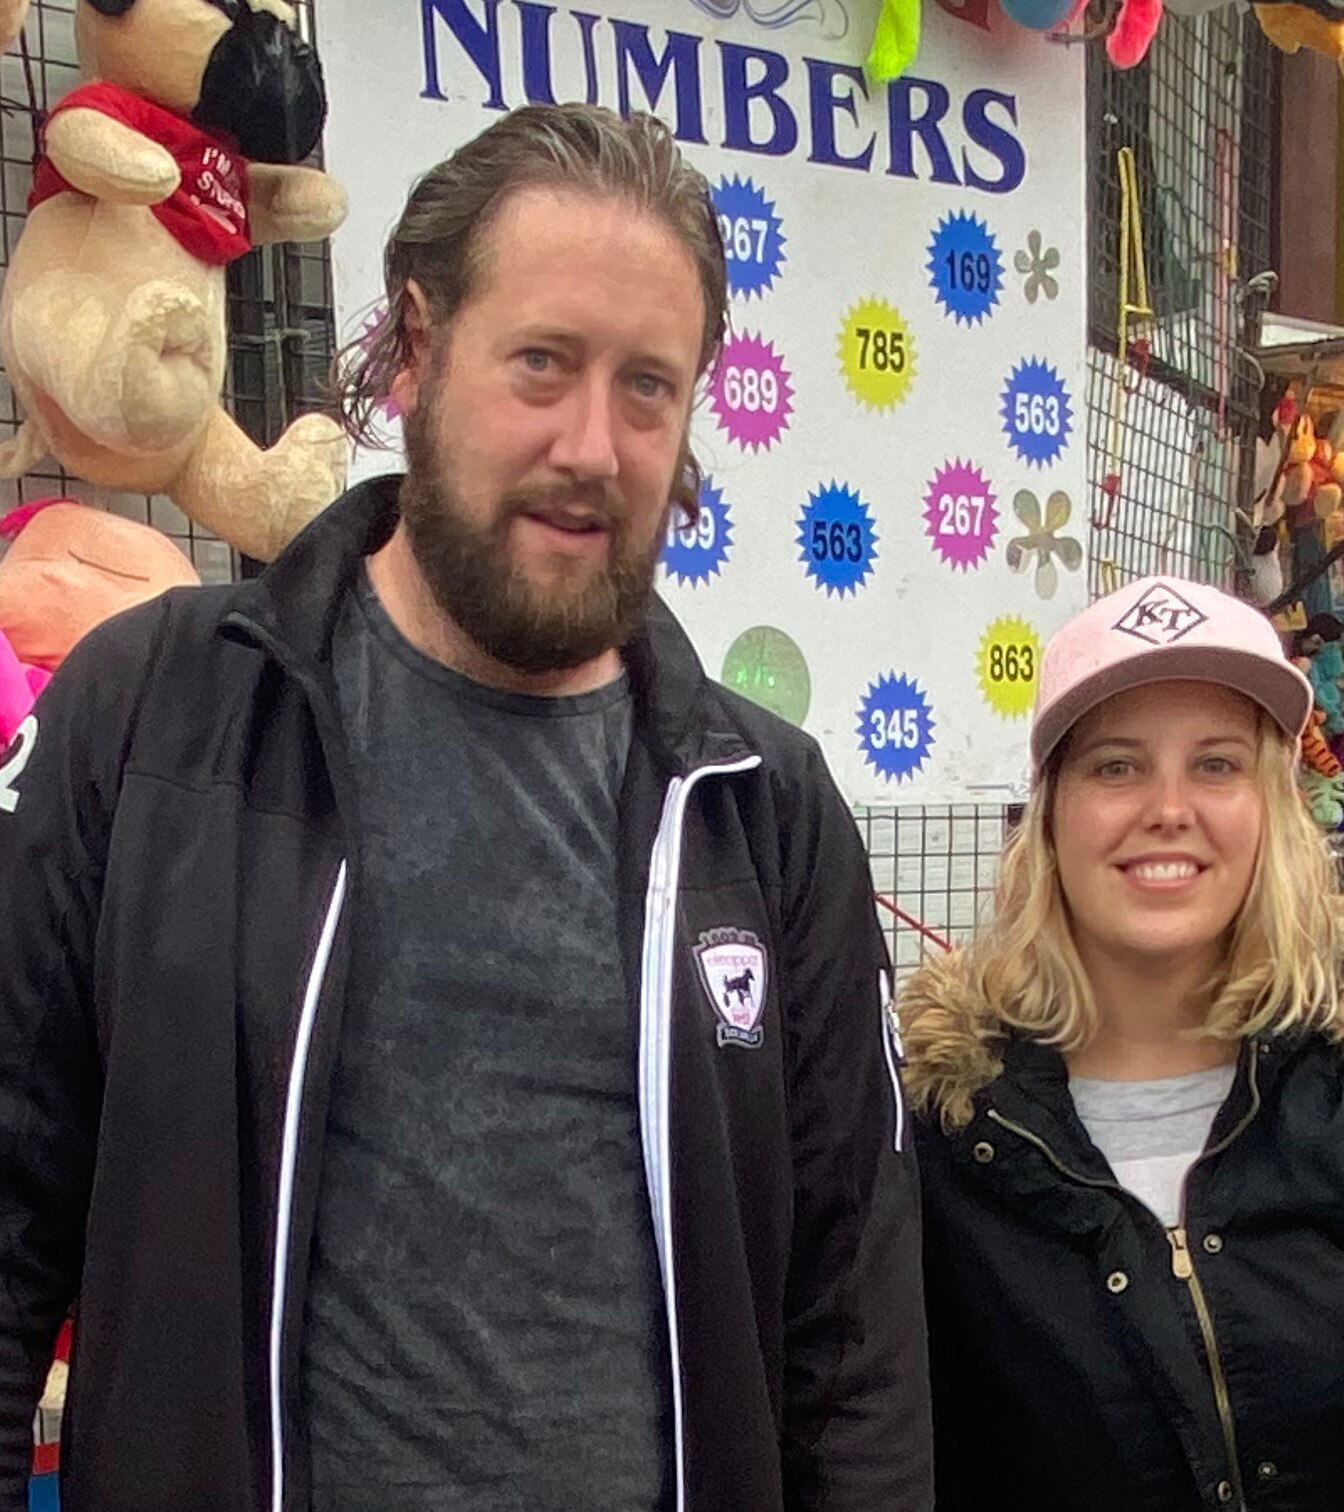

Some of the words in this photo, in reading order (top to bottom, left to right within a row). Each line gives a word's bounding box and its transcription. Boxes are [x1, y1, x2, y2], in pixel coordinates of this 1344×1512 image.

[419, 0, 1027, 196] NUMBERS
[717, 214, 769, 264] 267
[946, 249, 991, 294] 169
[856, 327, 906, 374] 785
[723, 366, 779, 413] 689
[1014, 392, 1060, 436] 563
[938, 493, 986, 537] 267
[812, 519, 863, 564] 563
[1132, 598, 1193, 632] KT
[989, 644, 1034, 682] 863
[870, 708, 920, 750] 345
